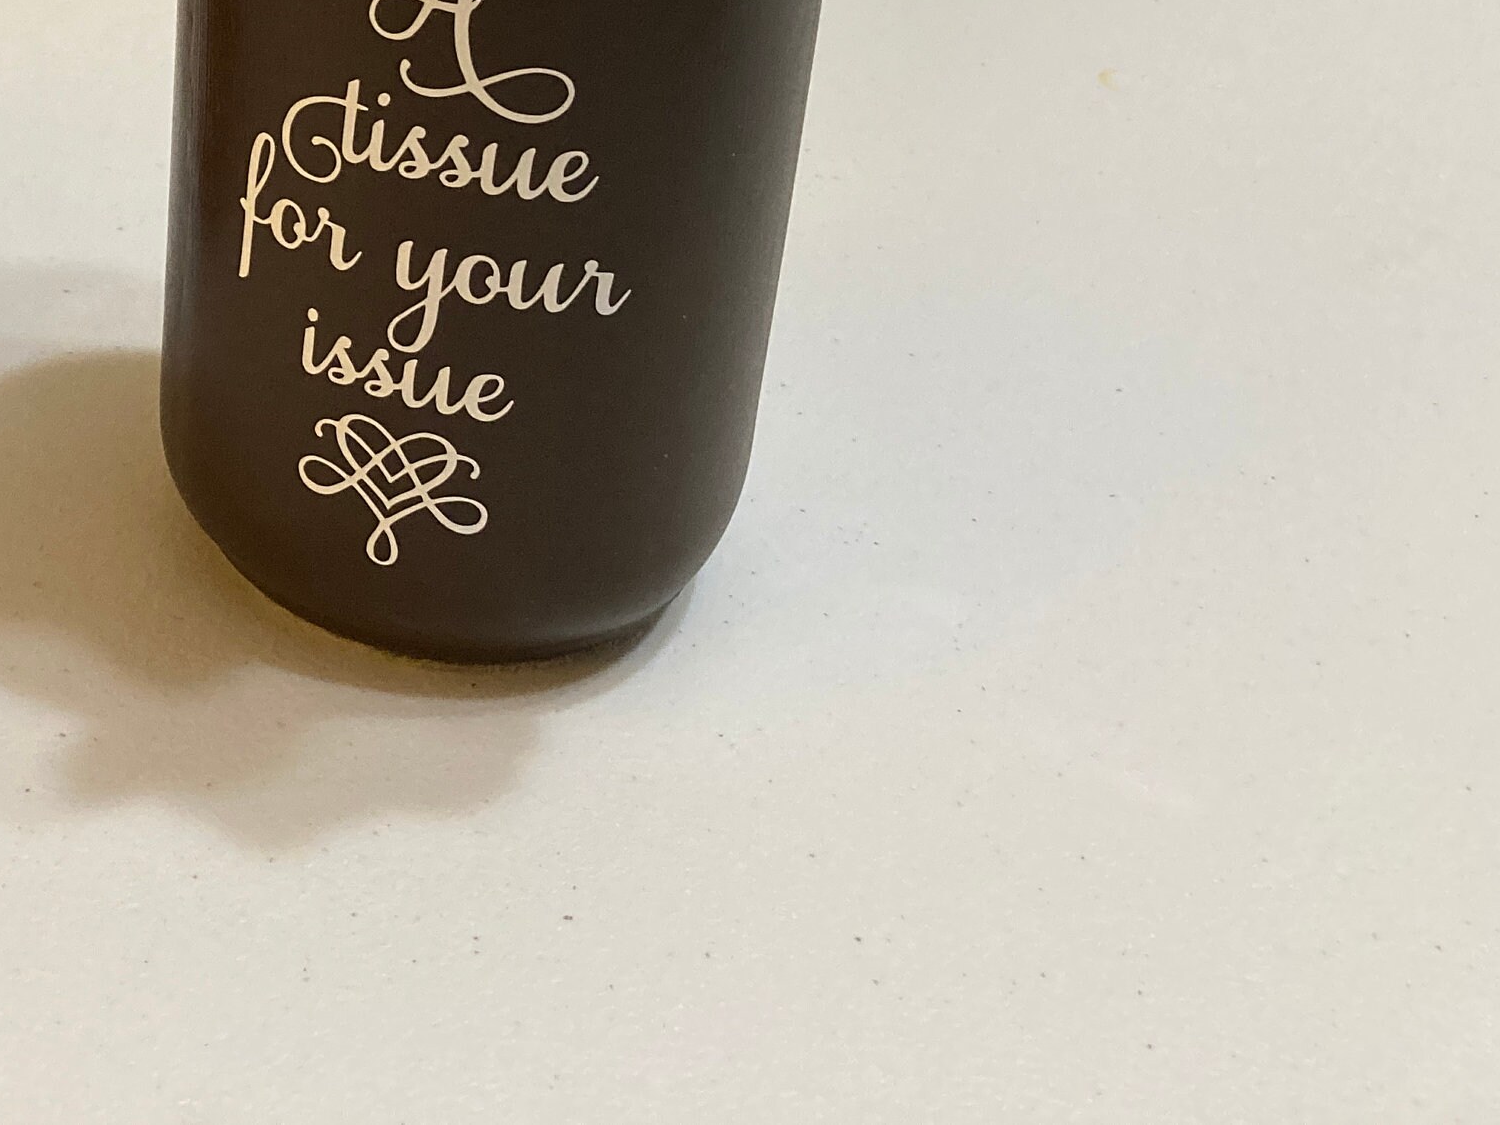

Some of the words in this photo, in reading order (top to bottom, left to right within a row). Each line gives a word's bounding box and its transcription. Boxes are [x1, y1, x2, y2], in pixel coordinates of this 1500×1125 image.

[281, 79, 599, 203] tissue
[238, 132, 362, 278] for
[386, 239, 632, 354] your
[301, 308, 514, 422] issue
